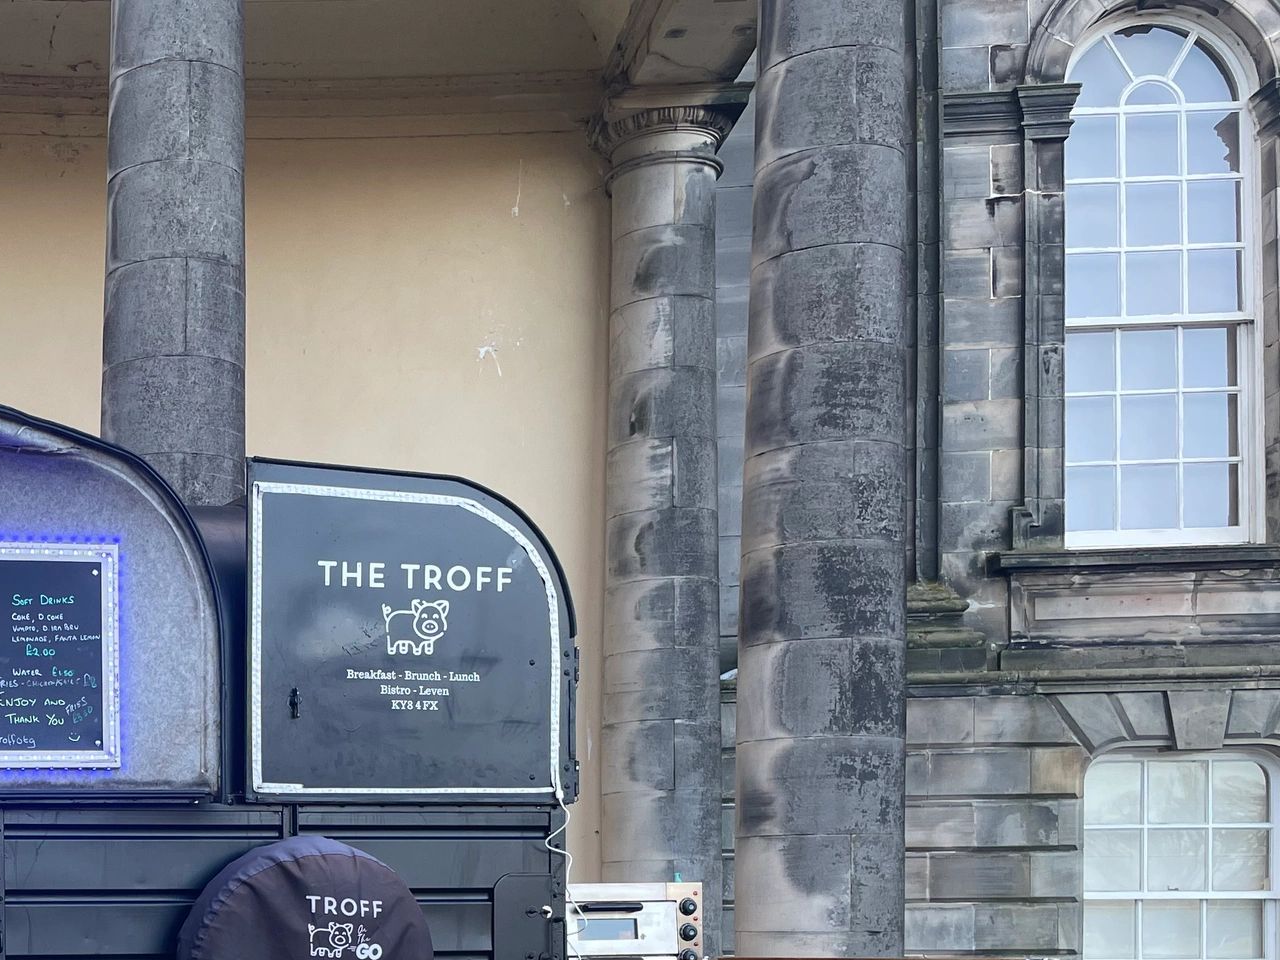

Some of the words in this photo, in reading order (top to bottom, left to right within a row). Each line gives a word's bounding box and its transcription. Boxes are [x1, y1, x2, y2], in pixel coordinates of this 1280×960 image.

[318, 560, 386, 588] THE
[400, 563, 514, 592] TROFF
[11, 594, 33, 606] SOFT
[40, 594, 75, 606] DRINKS
[346, 669, 396, 680] Breakfast
[404, 670, 442, 681] Brunch
[448, 672, 481, 682] Lunch
[380, 684, 411, 695] Bistro
[419, 686, 449, 696] Leven
[44, 698, 66, 706] AND
[392, 700, 413, 710] KY8
[5, 713, 40, 724] THANK
[306, 895, 383, 918] TROFF
[356, 943, 383, 960] GO
